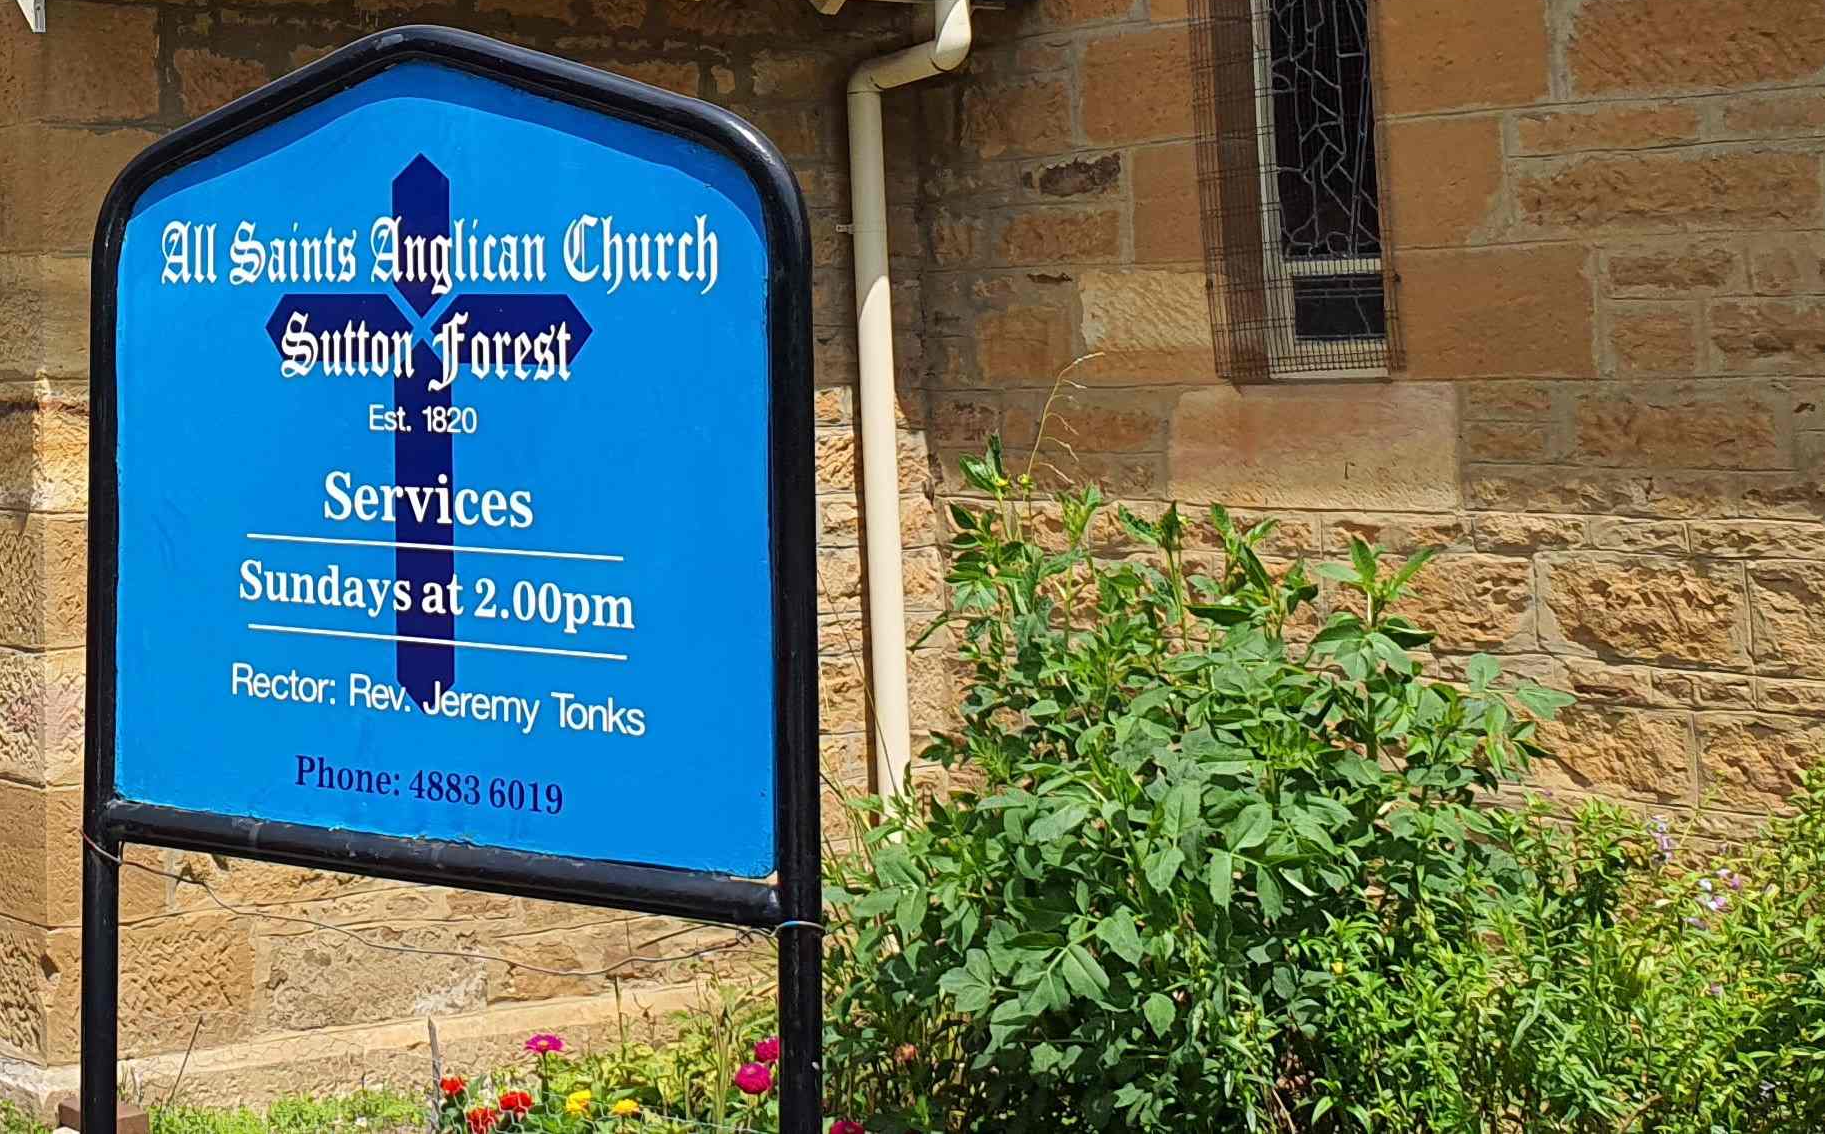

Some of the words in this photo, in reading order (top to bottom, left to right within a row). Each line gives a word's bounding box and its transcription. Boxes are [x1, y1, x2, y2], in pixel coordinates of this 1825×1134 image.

[161, 220, 217, 284] All
[229, 220, 357, 285] Saints
[370, 215, 547, 295] Anglican
[563, 214, 719, 296] Church
[280, 311, 415, 379] Sutton
[428, 311, 572, 392] Forest
[368, 404, 412, 432] Est.
[422, 405, 478, 434] 1820
[323, 471, 534, 529] Services
[239, 559, 412, 618] Sundays
[421, 573, 464, 616] at
[474, 577, 635, 634] 2.00pm
[232, 662, 336, 706] Rector:
[349, 673, 411, 713] Rev.
[422, 680, 540, 735] Jeremy
[550, 691, 646, 737] Tonks
[294, 754, 401, 797] Phone:
[409, 768, 481, 805] 4883
[489, 776, 564, 816] 6019
